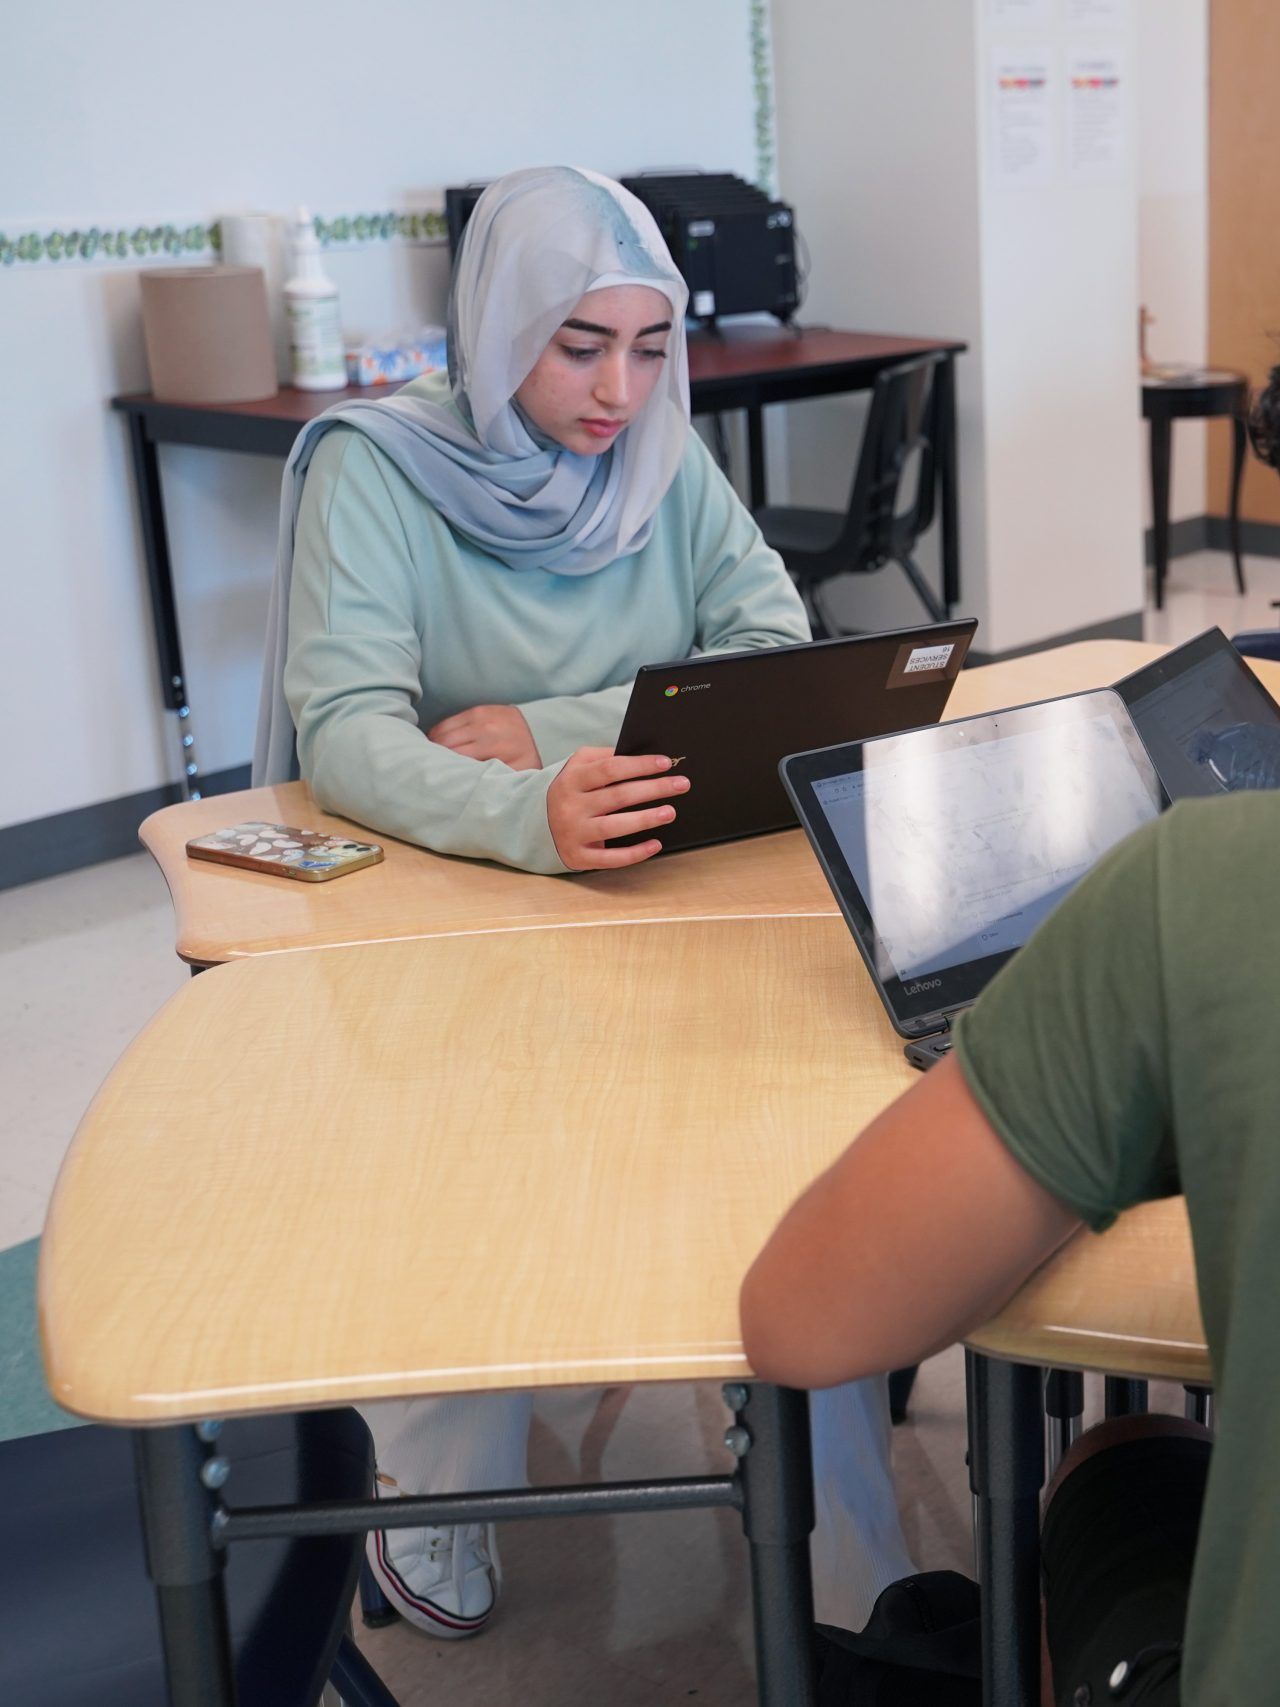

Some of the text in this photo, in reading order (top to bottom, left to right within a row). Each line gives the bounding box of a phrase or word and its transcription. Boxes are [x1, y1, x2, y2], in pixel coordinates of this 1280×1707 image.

[910, 653, 949, 664] SERVICES
[680, 683, 711, 692] chrome
[903, 979, 942, 996] Lenovo
